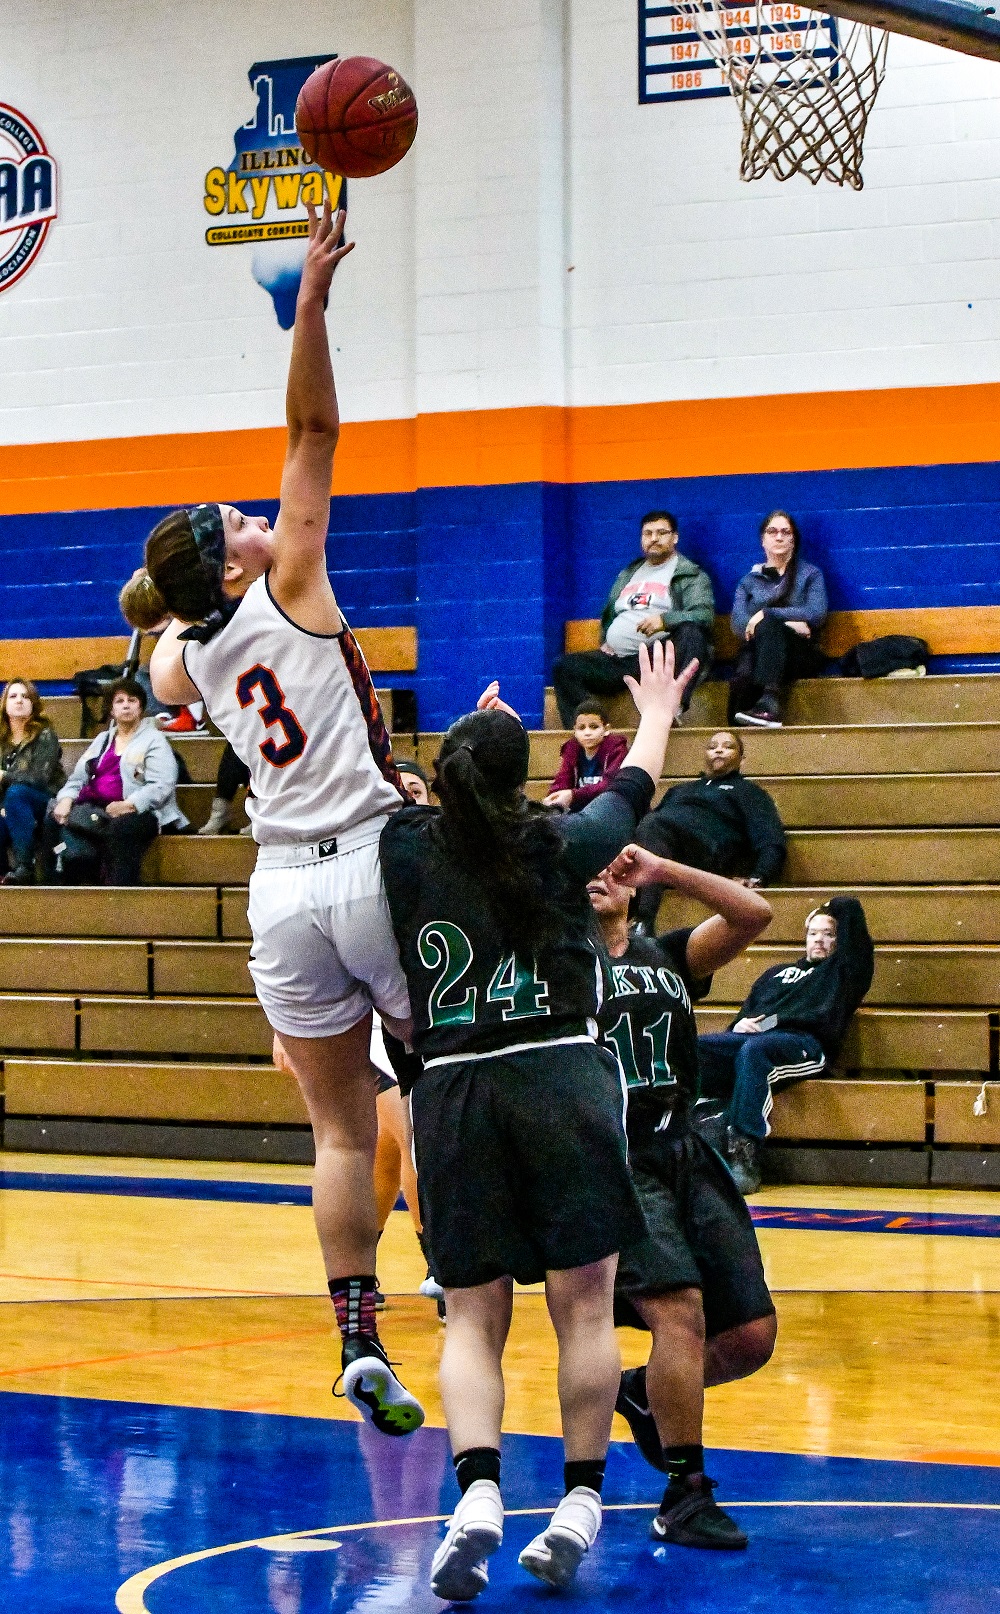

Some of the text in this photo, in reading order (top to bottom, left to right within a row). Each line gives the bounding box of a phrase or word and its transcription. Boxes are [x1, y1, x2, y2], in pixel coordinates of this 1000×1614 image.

[720, 10, 750, 27] 1944
[770, 4, 801, 22] 1945
[671, 43, 700, 60] 1947
[671, 72, 702, 89] 1986
[242, 148, 312, 171] ILLINO
[203, 166, 344, 220] Skyway
[267, 224, 309, 236] CONFERE
[235, 663, 308, 769] 3
[417, 920, 551, 1030] 24
[604, 1012, 678, 1089] 11
